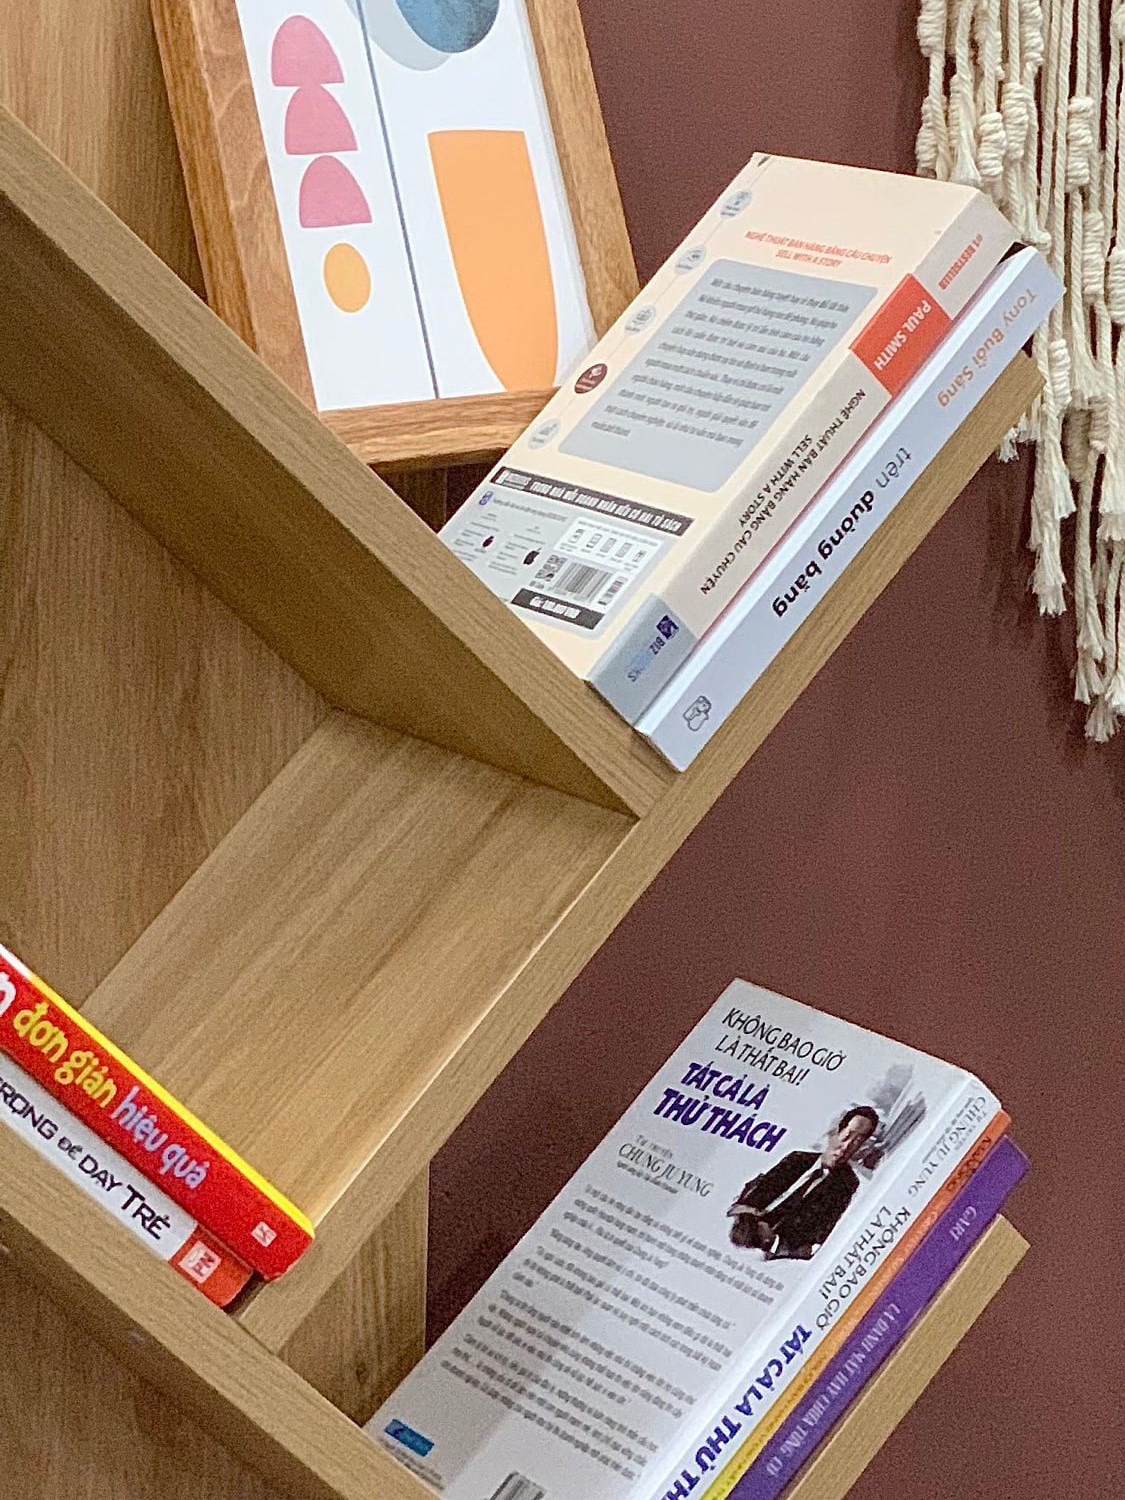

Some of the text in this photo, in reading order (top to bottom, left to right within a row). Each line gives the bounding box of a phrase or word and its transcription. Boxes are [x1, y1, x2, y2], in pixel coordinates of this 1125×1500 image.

[1003, 288, 1038, 327] Tony
[873, 299, 932, 371] PAUL SMITH
[937, 366, 974, 408] Sáng
[739, 434, 813, 528] SELL WITH A STORY
[875, 447, 912, 489] trên
[715, 1034, 740, 1061] LÀ
[721, 1007, 847, 1072] KHÔNG BAO GIỜ
[13, 1001, 69, 1063] đơn
[110, 1085, 168, 1152] hiệu
[741, 1083, 770, 1111] LÀ
[700, 1106, 788, 1153] THÁCH
[948, 1096, 986, 1142] CHUNG
[936, 1136, 951, 1160] JU
[618, 1143, 665, 1173] CHUNG
[653, 1163, 680, 1180] JU
[677, 1170, 714, 1197] YUNG
[908, 1161, 938, 1197] YUNG
[860, 1207, 911, 1266] KHÔNG
[839, 1264, 867, 1302] BAO
[816, 1299, 841, 1331] GIỜ
[734, 1384, 764, 1417] LÀ
